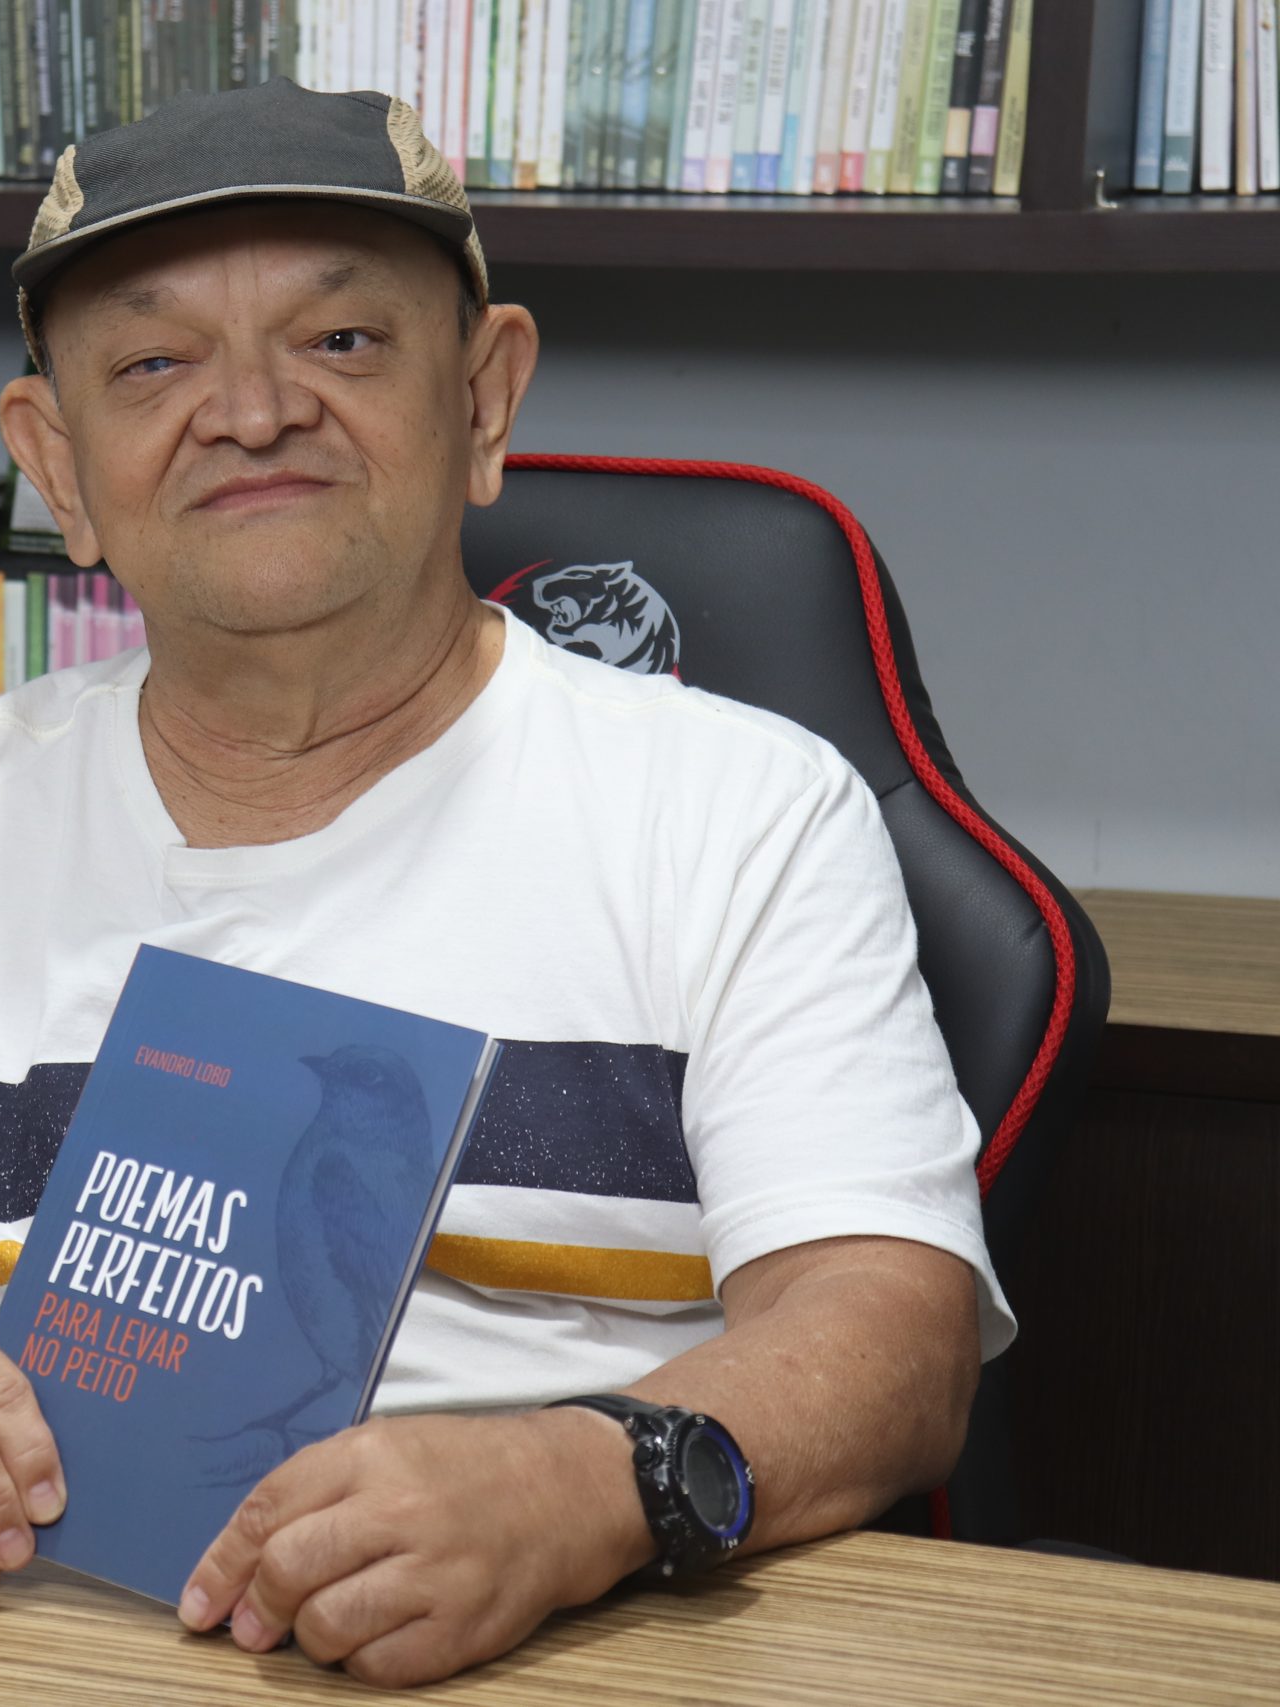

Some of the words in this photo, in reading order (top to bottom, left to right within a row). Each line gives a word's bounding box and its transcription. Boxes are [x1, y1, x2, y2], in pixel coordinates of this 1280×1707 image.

[134, 1045, 195, 1078] EVANDRO
[195, 1060, 232, 1088] LOBO
[75, 1150, 248, 1254] POEMAS
[47, 1220, 263, 1340] PERFEITOS
[19, 1332, 61, 1377] NO
[59, 1345, 139, 1403] PEITO
[33, 1290, 103, 1347] PARA
[104, 1314, 190, 1374] LEVAR
